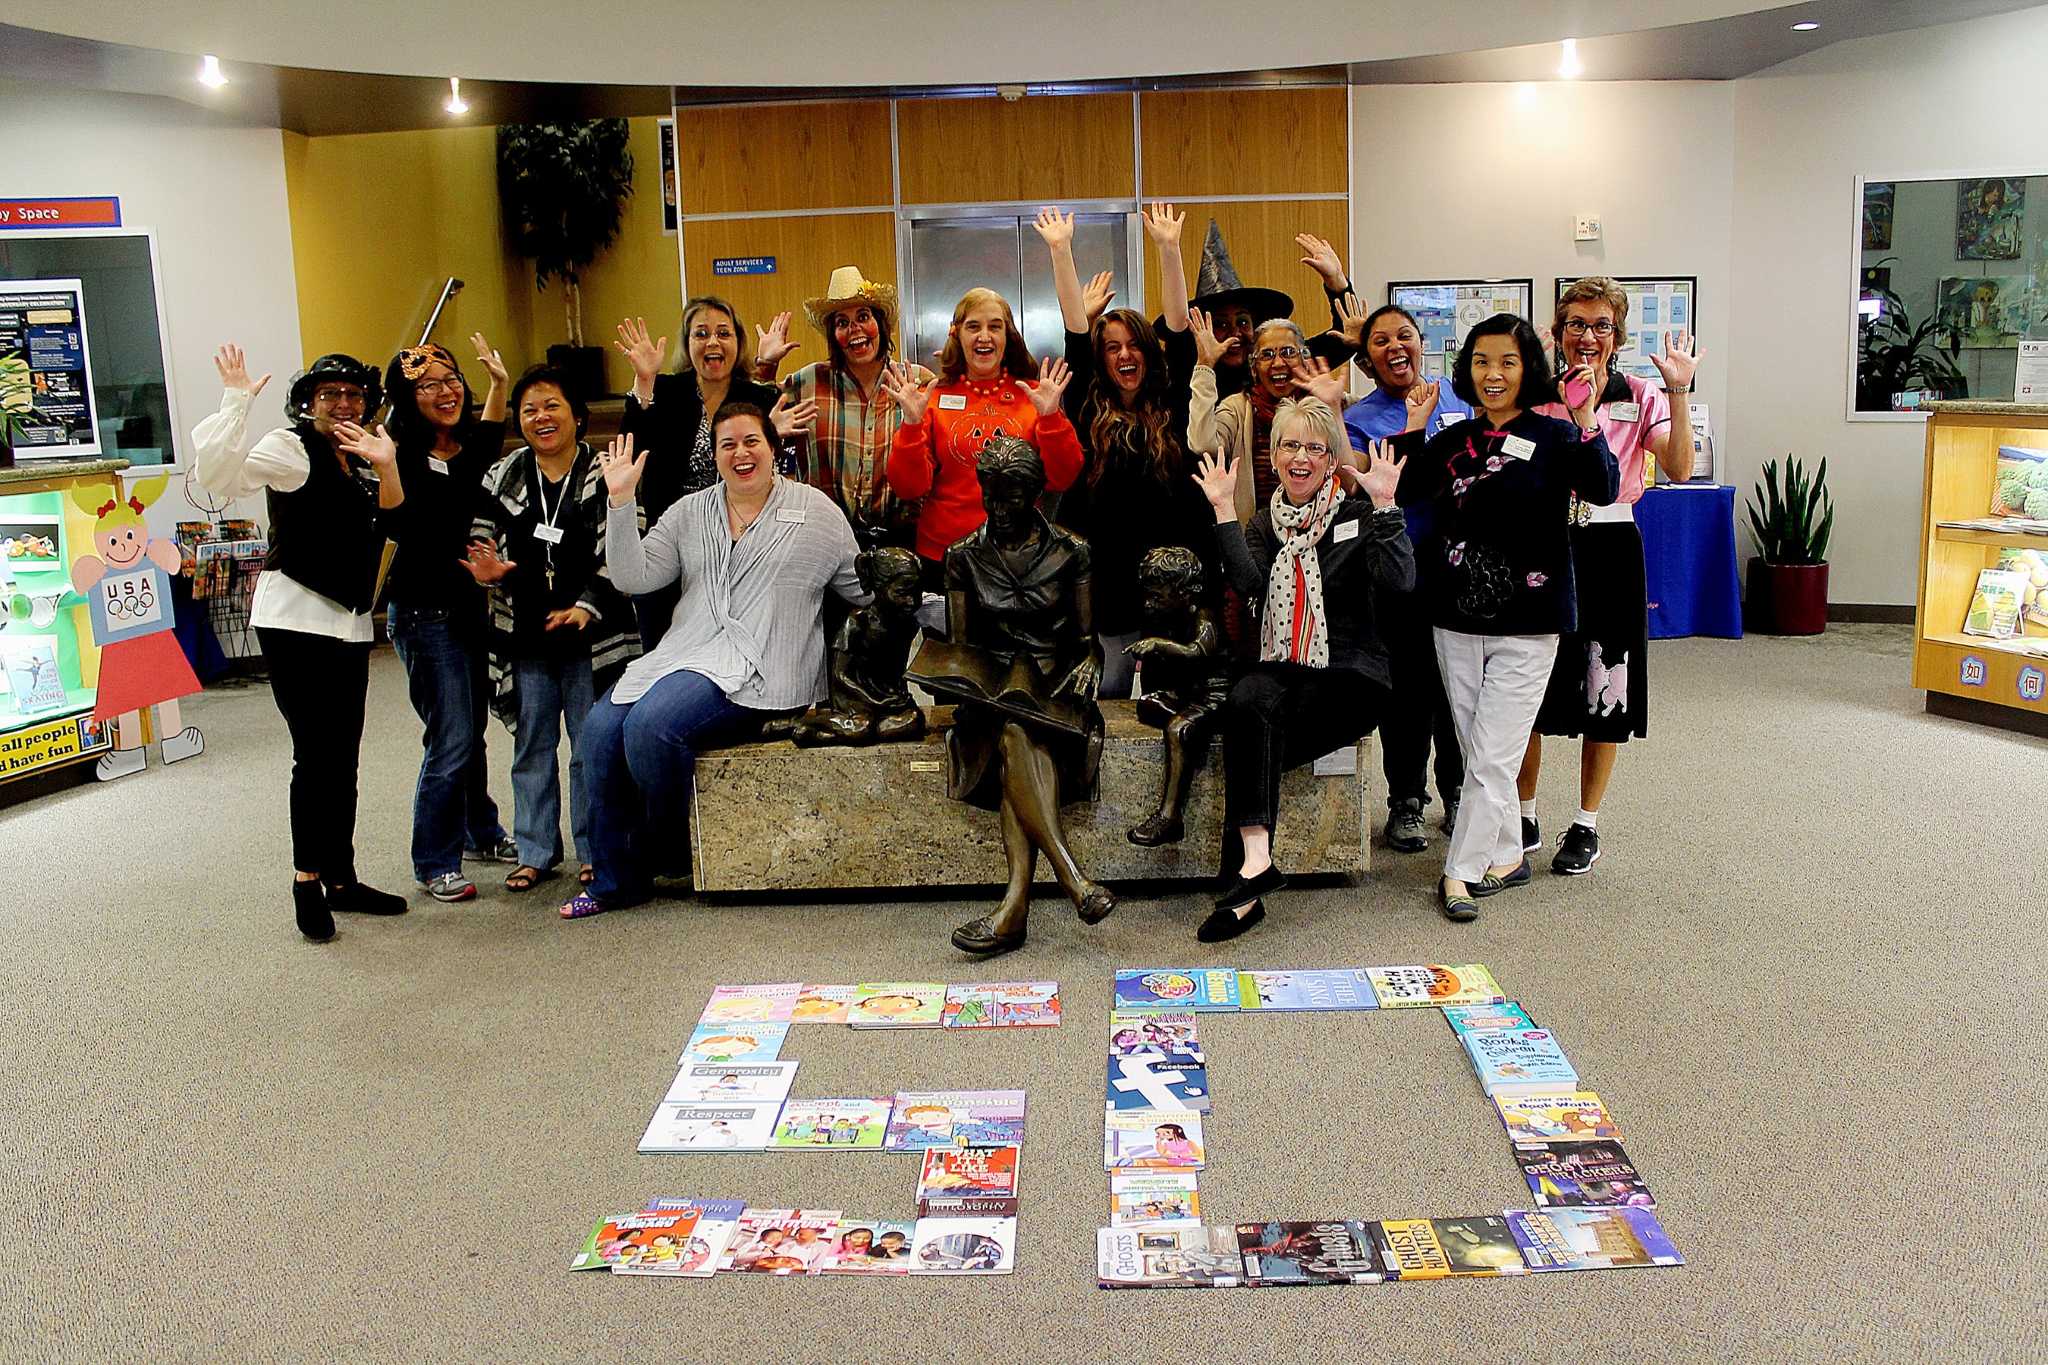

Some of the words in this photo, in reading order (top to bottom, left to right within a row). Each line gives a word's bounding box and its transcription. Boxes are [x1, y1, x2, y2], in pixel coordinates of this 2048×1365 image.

[18, 207, 60, 222] Space
[735, 258, 764, 266] SERVICES
[1966, 662, 1980, 679] 如
[2024, 675, 2039, 693] 何
[2, 738, 23, 752] all
[25, 725, 76, 749] people
[9, 752, 44, 770] have
[48, 744, 74, 758] fun
[1478, 1037, 1530, 1047] Books
[694, 1066, 780, 1077] Generosity
[683, 1109, 751, 1120] Respect
[949, 1148, 996, 1158] WHAT
[950, 1163, 989, 1173] LIKE
[1525, 1158, 1585, 1175] GHOST
[1550, 1165, 1635, 1180] TRACKERS
[750, 1218, 829, 1229] GRATITUDE
[879, 1221, 904, 1231] Fair
[1388, 1229, 1423, 1270] GHOST
[1408, 1223, 1445, 1269] HUNTERS
[1116, 1234, 1138, 1276] GHOSTS
